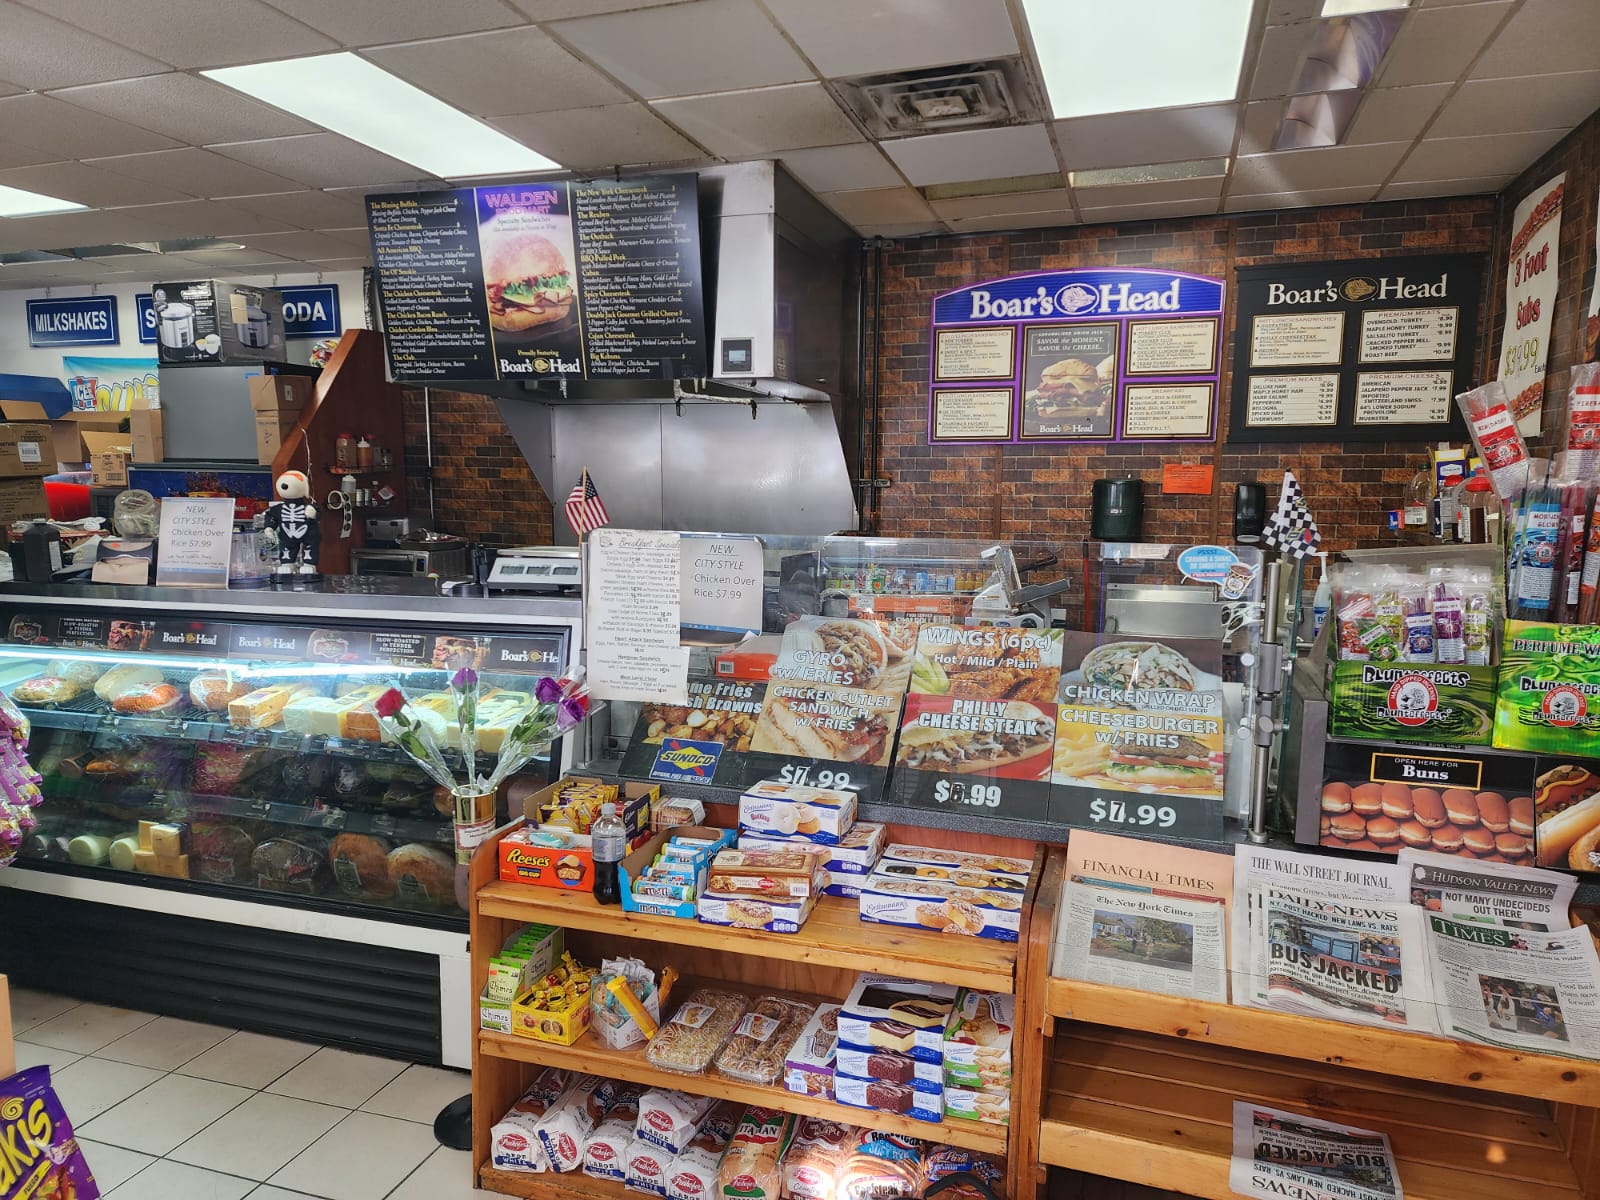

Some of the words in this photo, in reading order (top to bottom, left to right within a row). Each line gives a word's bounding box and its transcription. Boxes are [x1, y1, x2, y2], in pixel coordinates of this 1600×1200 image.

[485, 190, 558, 208] WALDEN
[581, 254, 594, 262] BBQ
[1514, 257, 1522, 287] 3
[1524, 242, 1549, 284] Foot
[1267, 280, 1338, 305] Boar's
[1378, 273, 1448, 300] Head
[970, 287, 1053, 319] Boar's
[1098, 278, 1181, 312] Head
[282, 301, 327, 322] ODA
[1516, 295, 1541, 330] Subs
[34, 310, 108, 333] MILKSHAKES
[500, 359, 533, 372] Boar's
[549, 358, 581, 373] Head
[1039, 424, 1062, 433] Boar's
[1072, 424, 1093, 433] Head
[186, 505, 208, 513] NEW
[172, 517, 191, 525] CITY
[191, 517, 217, 525] STYLE
[171, 528, 203, 537] Chicken
[204, 529, 225, 537] Over
[171, 540, 188, 548] Rice
[709, 544, 735, 554] NEW
[694, 559, 716, 568] CITY
[717, 560, 745, 570] STYLE
[694, 573, 731, 584] Chicken
[733, 577, 756, 587] Over
[694, 588, 713, 598] Rice
[716, 589, 742, 600] $7.99
[163, 632, 185, 644] Boar's
[195, 633, 217, 645] Head
[239, 637, 262, 648] Boar's
[273, 638, 295, 650] Head
[926, 628, 995, 648] WINGS
[1001, 631, 1053, 651] (6pc)
[1513, 639, 1580, 655] PERFUME
[501, 650, 529, 663] Boar's
[542, 652, 560, 663] He
[794, 650, 846, 667] GYRO
[934, 654, 959, 666] Hot
[967, 656, 996, 668] Mild
[1005, 657, 1038, 670] Plain
[803, 668, 855, 686] FRIES
[715, 682, 753, 698] Fries
[773, 686, 835, 702] CHICKEN
[838, 692, 894, 708] CUTLET
[1065, 684, 1149, 704] CHICKEN
[1152, 691, 1216, 708] WRAP
[706, 696, 763, 714] Browns
[789, 701, 870, 720] SANDWICH
[953, 700, 1008, 718] PHILLY
[813, 718, 856, 731] FRIES
[919, 713, 982, 732] CHEESE
[983, 717, 1039, 737] STEAK
[1061, 709, 1218, 735] CHEESEBURGER
[1123, 731, 1180, 748] FRIES
[663, 752, 714, 765] SUNOCO
[1402, 764, 1449, 780] Buns
[1089, 798, 1177, 827] $7.99
[506, 849, 550, 867] Reese's
[1083, 859, 1163, 883] FINANCIAL
[1166, 874, 1215, 891] TIMES
[1251, 856, 1271, 871] THE
[1273, 860, 1300, 875] WALL
[1303, 865, 1342, 882] STREET
[1432, 871, 1481, 887] HUDSON
[1484, 878, 1522, 892] VALLEY
[1523, 883, 1555, 896] NEWS
[1096, 895, 1113, 905] The
[1114, 898, 1136, 909] New
[1137, 899, 1162, 912] York
[1163, 905, 1194, 917] Times
[1268, 889, 1325, 911] DAILY
[1332, 903, 1399, 922] NEWS
[1445, 892, 1463, 902] NOT
[1465, 894, 1490, 906] MANY
[1493, 897, 1551, 913] UNDECIDEDS
[1284, 903, 1300, 912] POST
[1302, 909, 1329, 922] HACKED
[1331, 916, 1346, 925] NEW
[1348, 919, 1366, 929] LAWS
[1380, 923, 1399, 932] RATS
[1473, 905, 1491, 916] OUT
[1493, 907, 1522, 919] THERE
[1434, 918, 1506, 947] TIMES
[643, 1132, 668, 1147] WHITE
[588, 1161, 614, 1169] LARGE
[1254, 1163, 1271, 1175] RATS
[633, 1172, 659, 1185] LARGE
[1287, 1171, 1305, 1183] LAWS
[1306, 1175, 1322, 1187] NEW
[1326, 1182, 1357, 1198] HACKED
